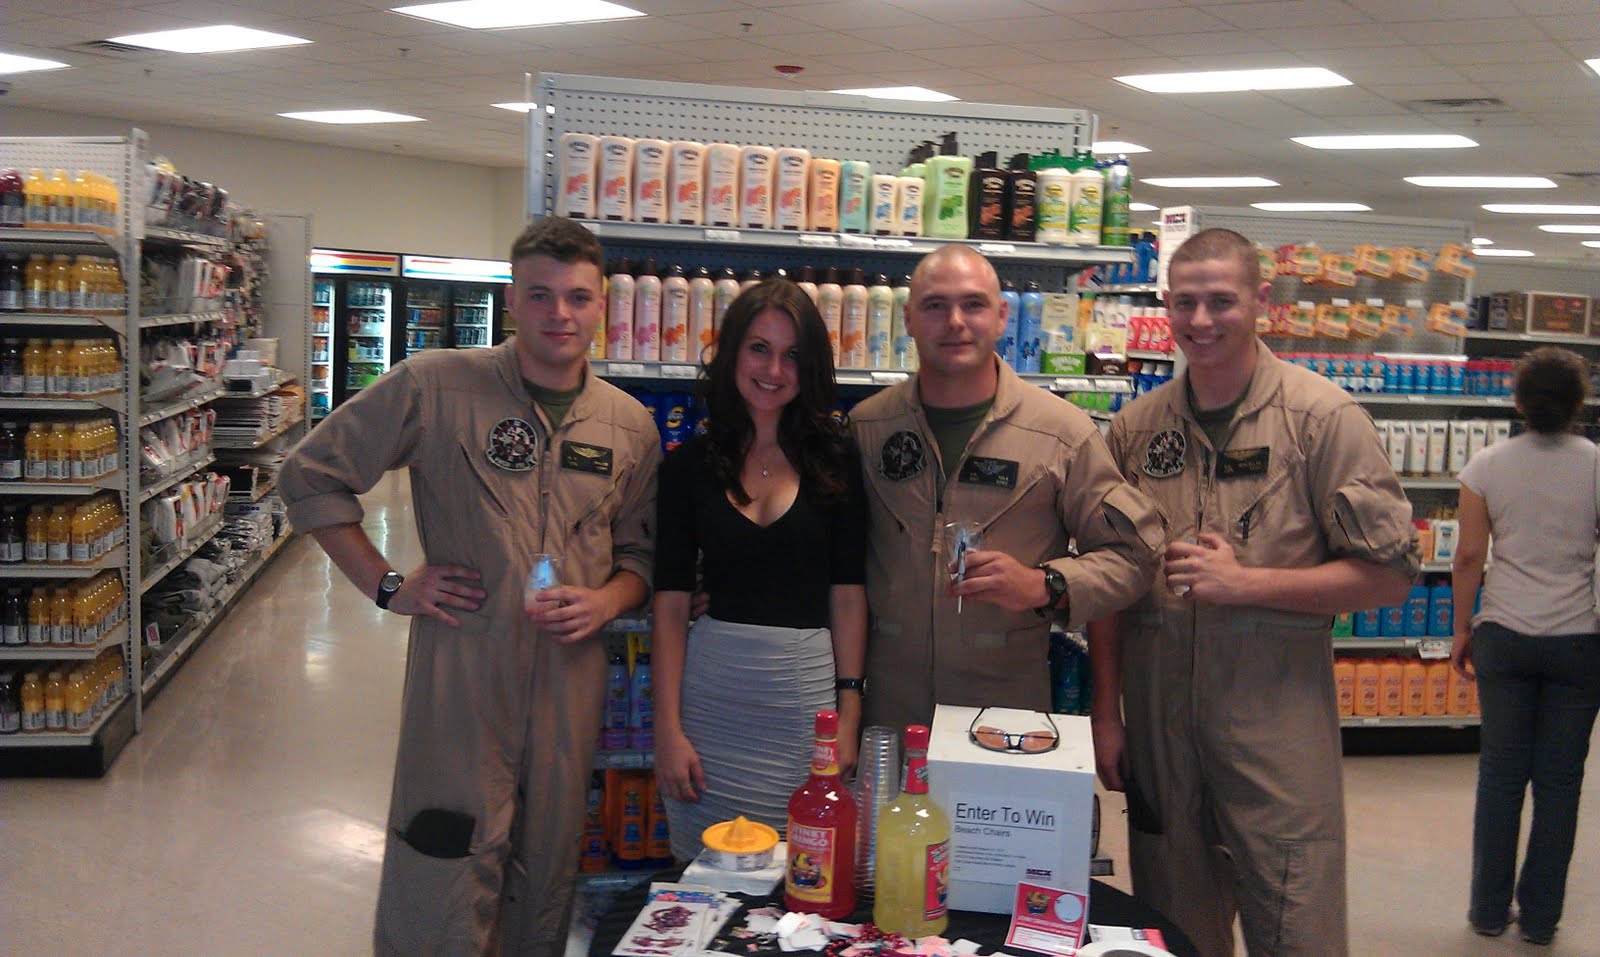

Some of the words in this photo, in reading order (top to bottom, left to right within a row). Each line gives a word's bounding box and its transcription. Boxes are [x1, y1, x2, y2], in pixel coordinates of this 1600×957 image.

[956, 803, 997, 820] Enter
[1001, 806, 1020, 823] To
[1025, 809, 1055, 826] Win
[955, 825, 981, 834] Beach
[983, 827, 1011, 837] Chairs
